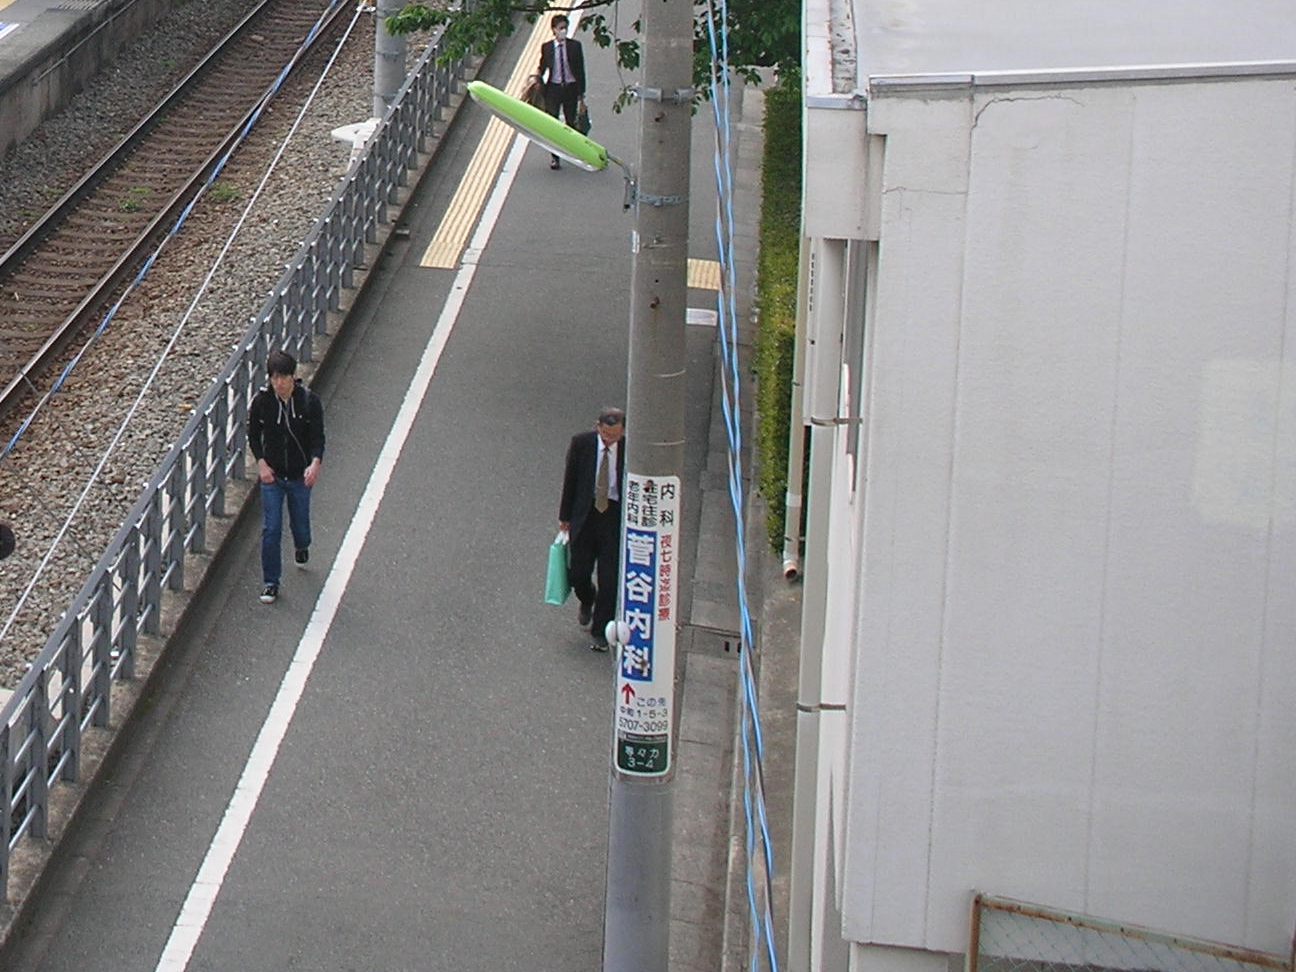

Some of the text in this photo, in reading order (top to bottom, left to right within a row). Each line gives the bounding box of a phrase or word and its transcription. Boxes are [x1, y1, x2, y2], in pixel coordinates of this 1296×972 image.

[660, 483, 675, 527] 内科
[623, 532, 654, 677] 菅谷内科
